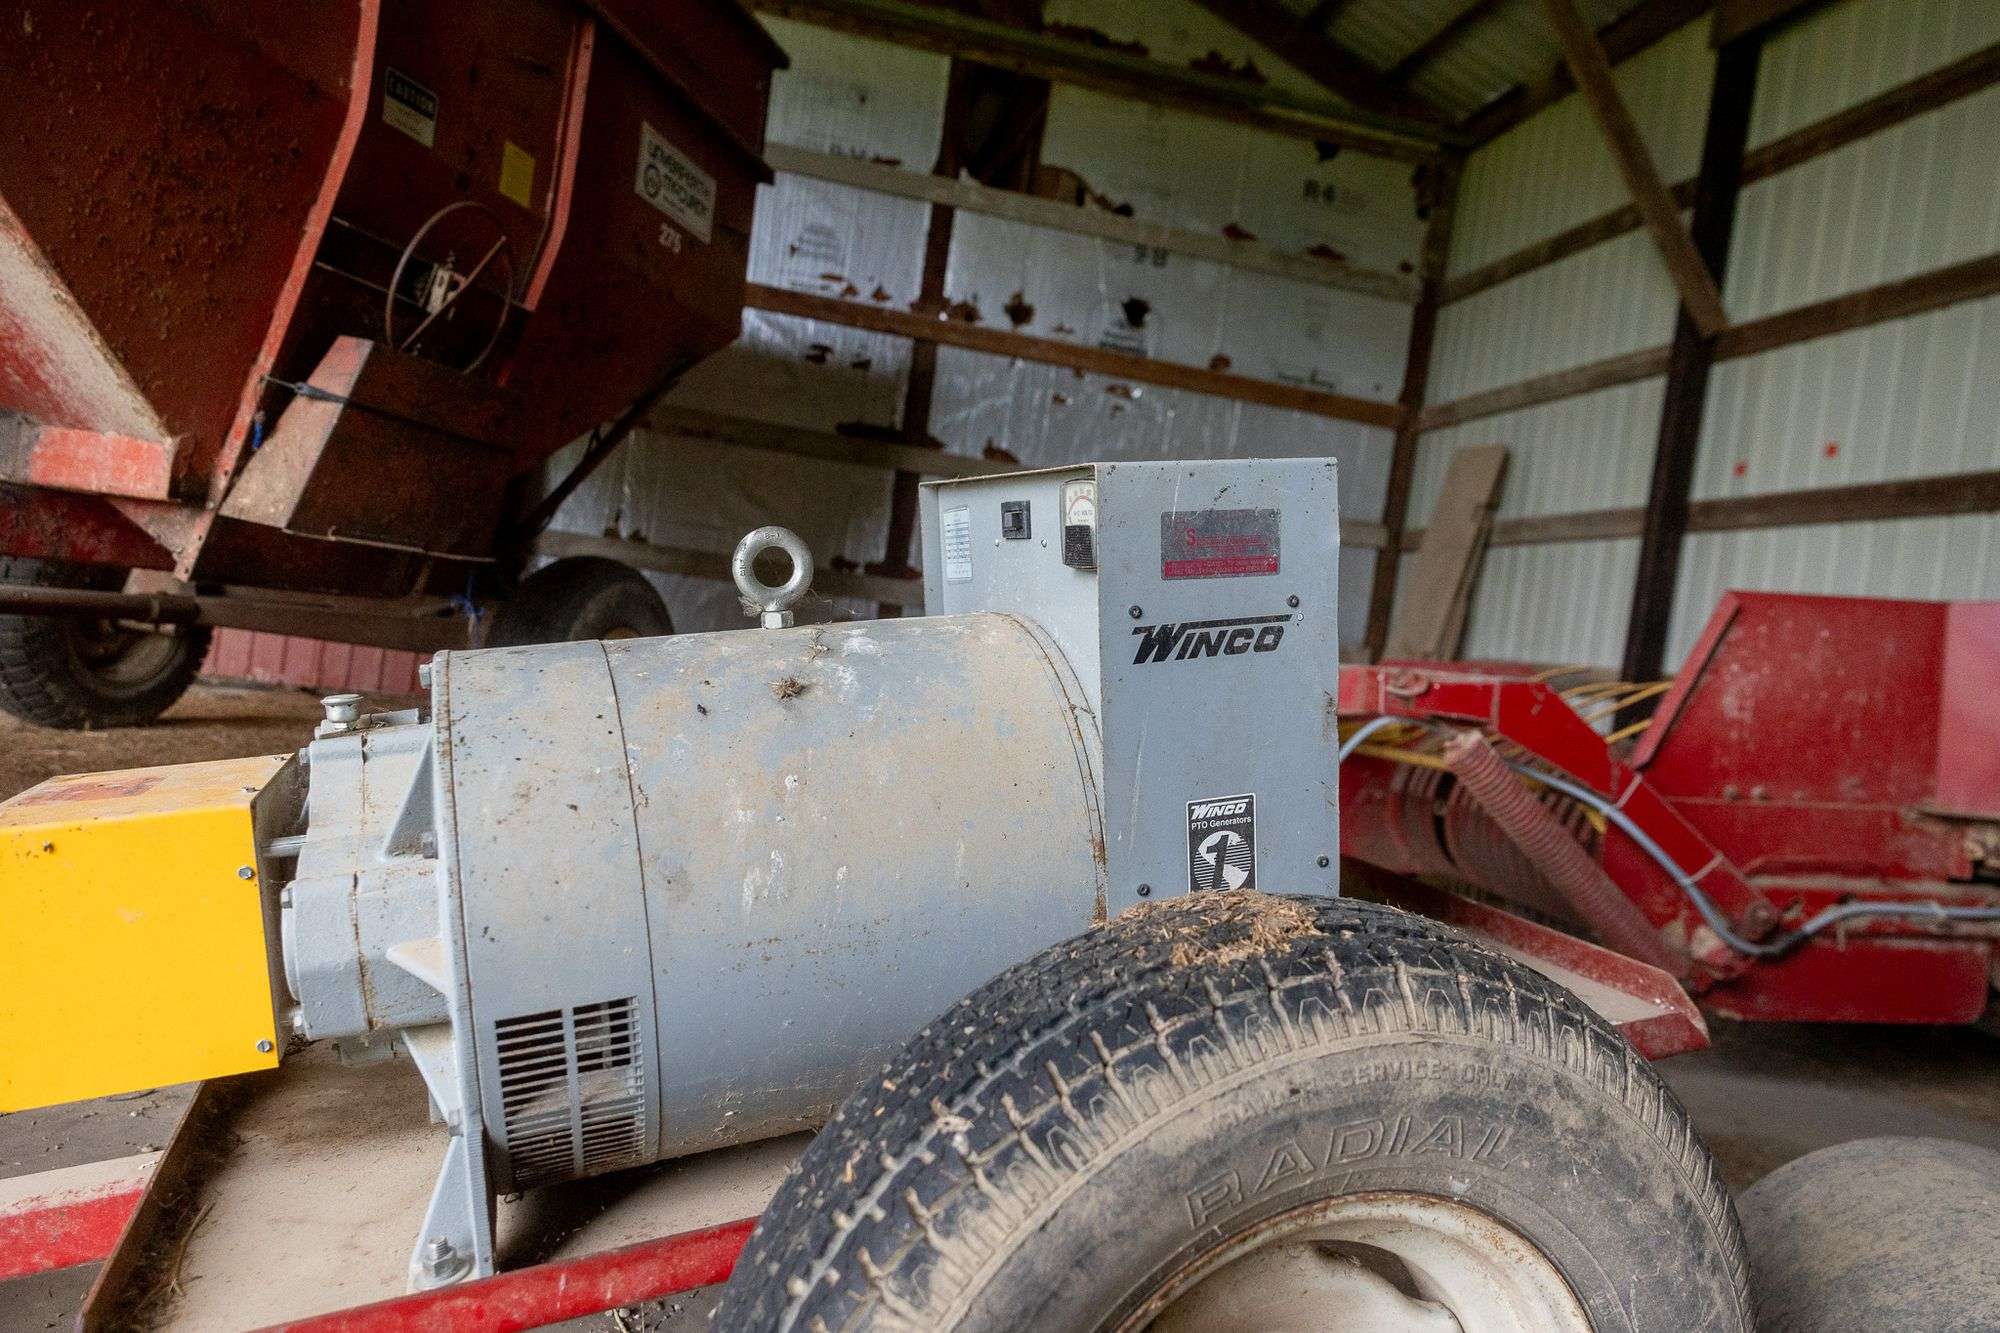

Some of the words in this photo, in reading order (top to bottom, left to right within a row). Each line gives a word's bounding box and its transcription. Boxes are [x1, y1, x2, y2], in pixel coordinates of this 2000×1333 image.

[1132, 614, 1293, 665] WINCO
[1190, 799, 1250, 820] WINCO
[1191, 821, 1208, 830] PTO
[1209, 816, 1252, 828] Generators
[1185, 1115, 1518, 1231] RADIAL
